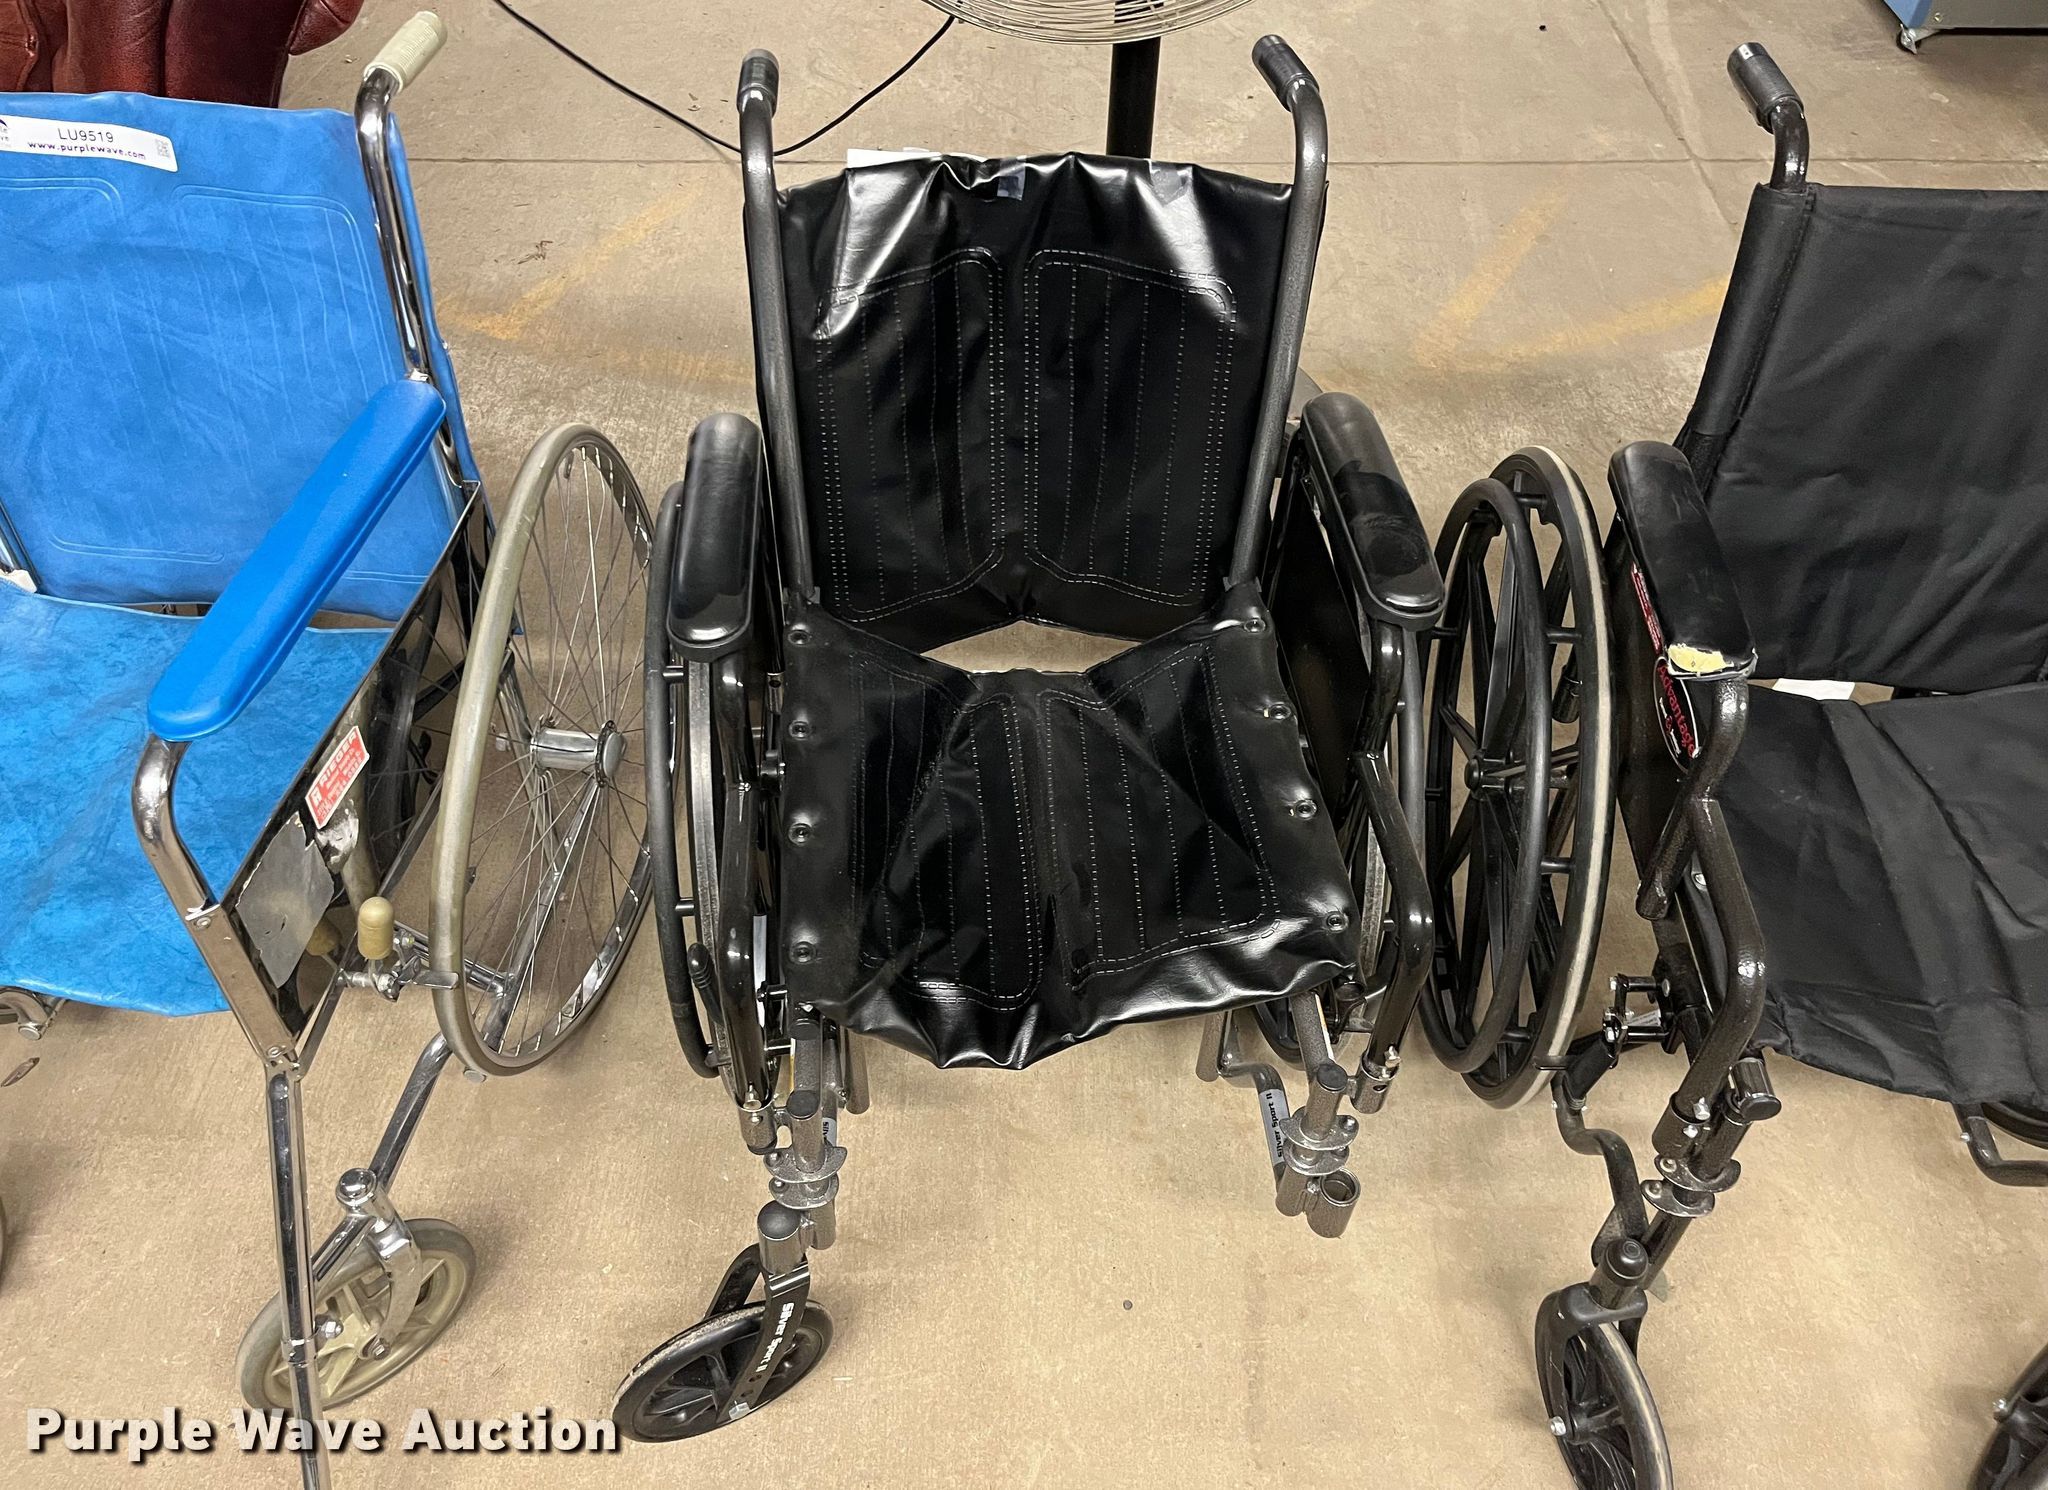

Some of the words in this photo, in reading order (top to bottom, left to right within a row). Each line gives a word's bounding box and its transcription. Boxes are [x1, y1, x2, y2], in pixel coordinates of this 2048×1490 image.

[58, 128, 114, 142] LU9519
[28, 141, 147, 160] www.purplewave.com
[1657, 665, 1696, 759] Advantage
[1268, 1102, 1279, 1128] Sport
[1274, 1130, 1283, 1158] Silver
[776, 1302, 794, 1335] Silver
[760, 1337, 783, 1364] Sport
